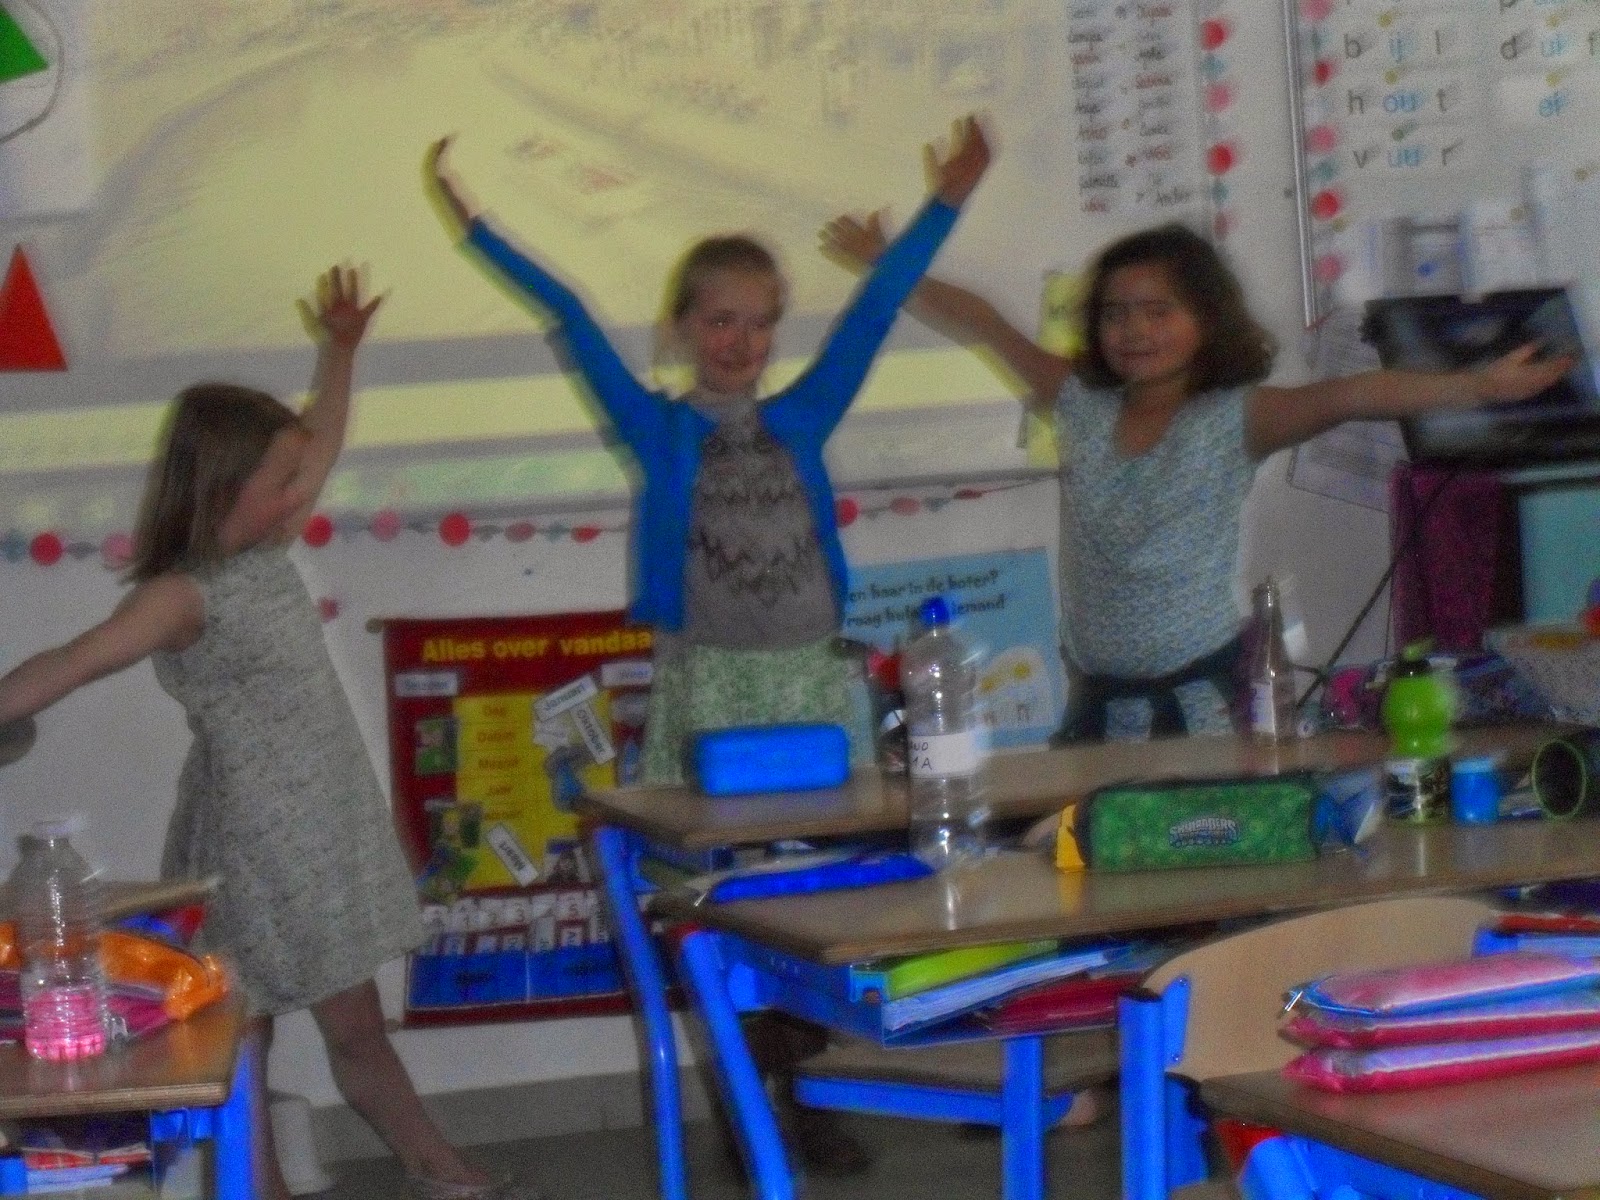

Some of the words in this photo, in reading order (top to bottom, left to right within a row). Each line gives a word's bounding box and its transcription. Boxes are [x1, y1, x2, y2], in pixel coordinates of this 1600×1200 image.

[846, 615, 882, 630] raag
[422, 638, 486, 663] Alles
[491, 638, 549, 659] over
[559, 630, 655, 657] vandaa
